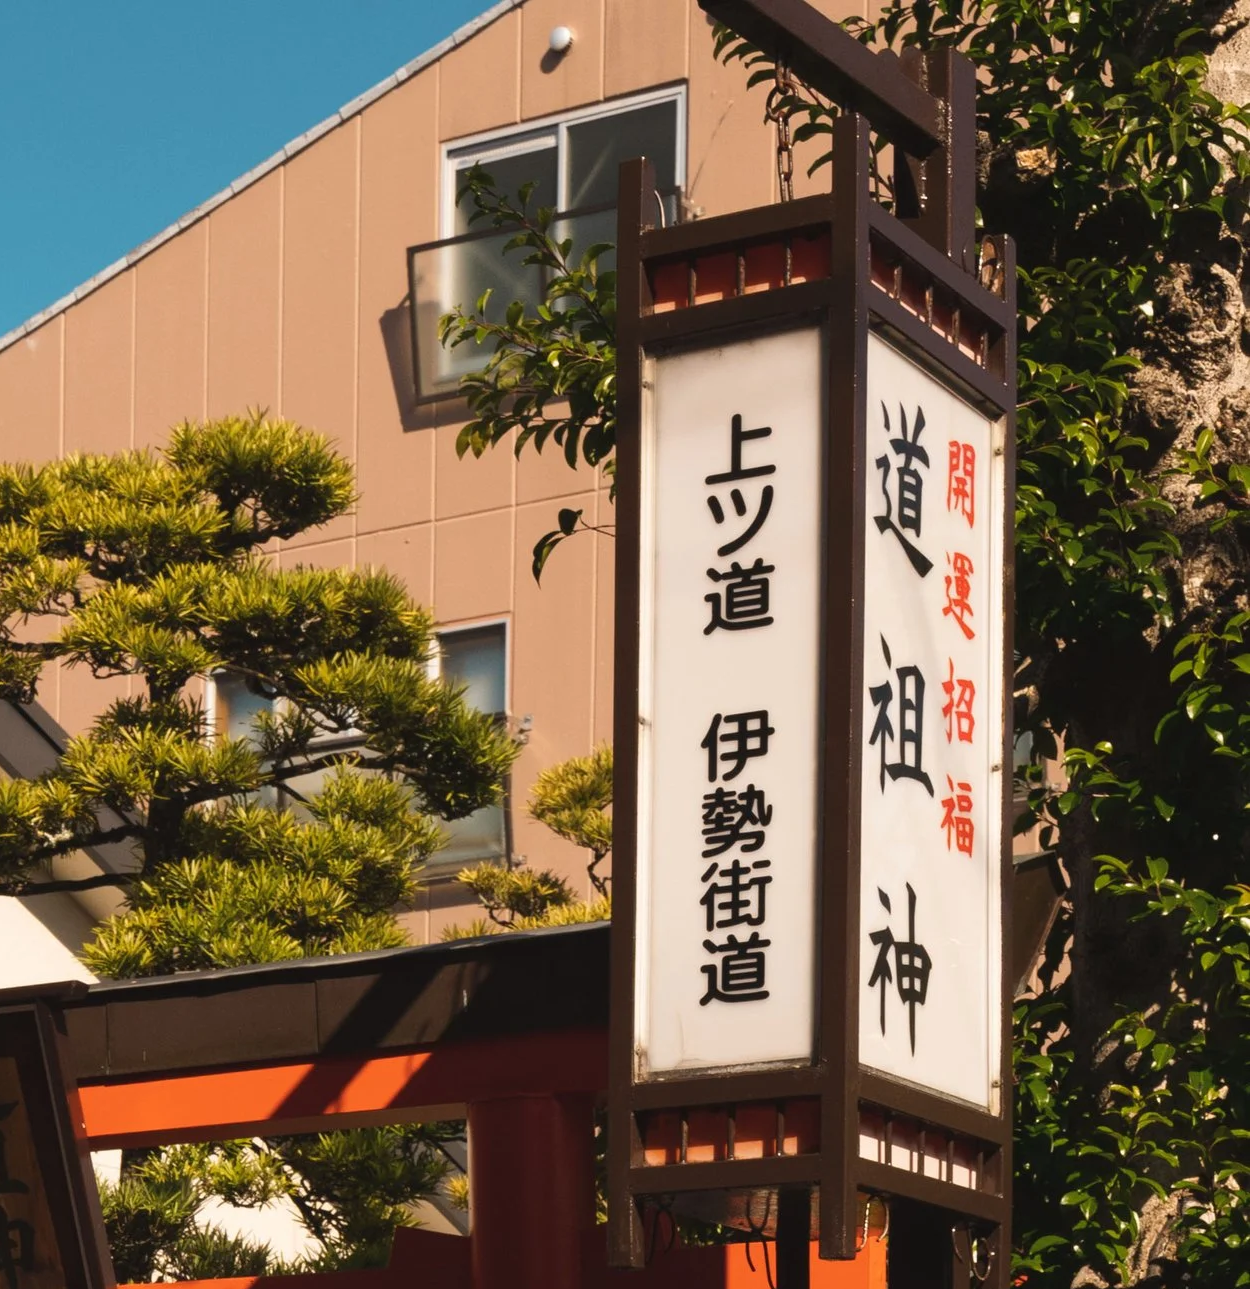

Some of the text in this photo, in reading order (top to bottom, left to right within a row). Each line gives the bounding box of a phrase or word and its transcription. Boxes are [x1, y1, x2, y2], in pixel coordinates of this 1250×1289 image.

[699, 412, 777, 1008] 上ツ道 伊勢街道
[867, 400, 935, 1058] 道祖神
[940, 440, 978, 858] 開運招福
